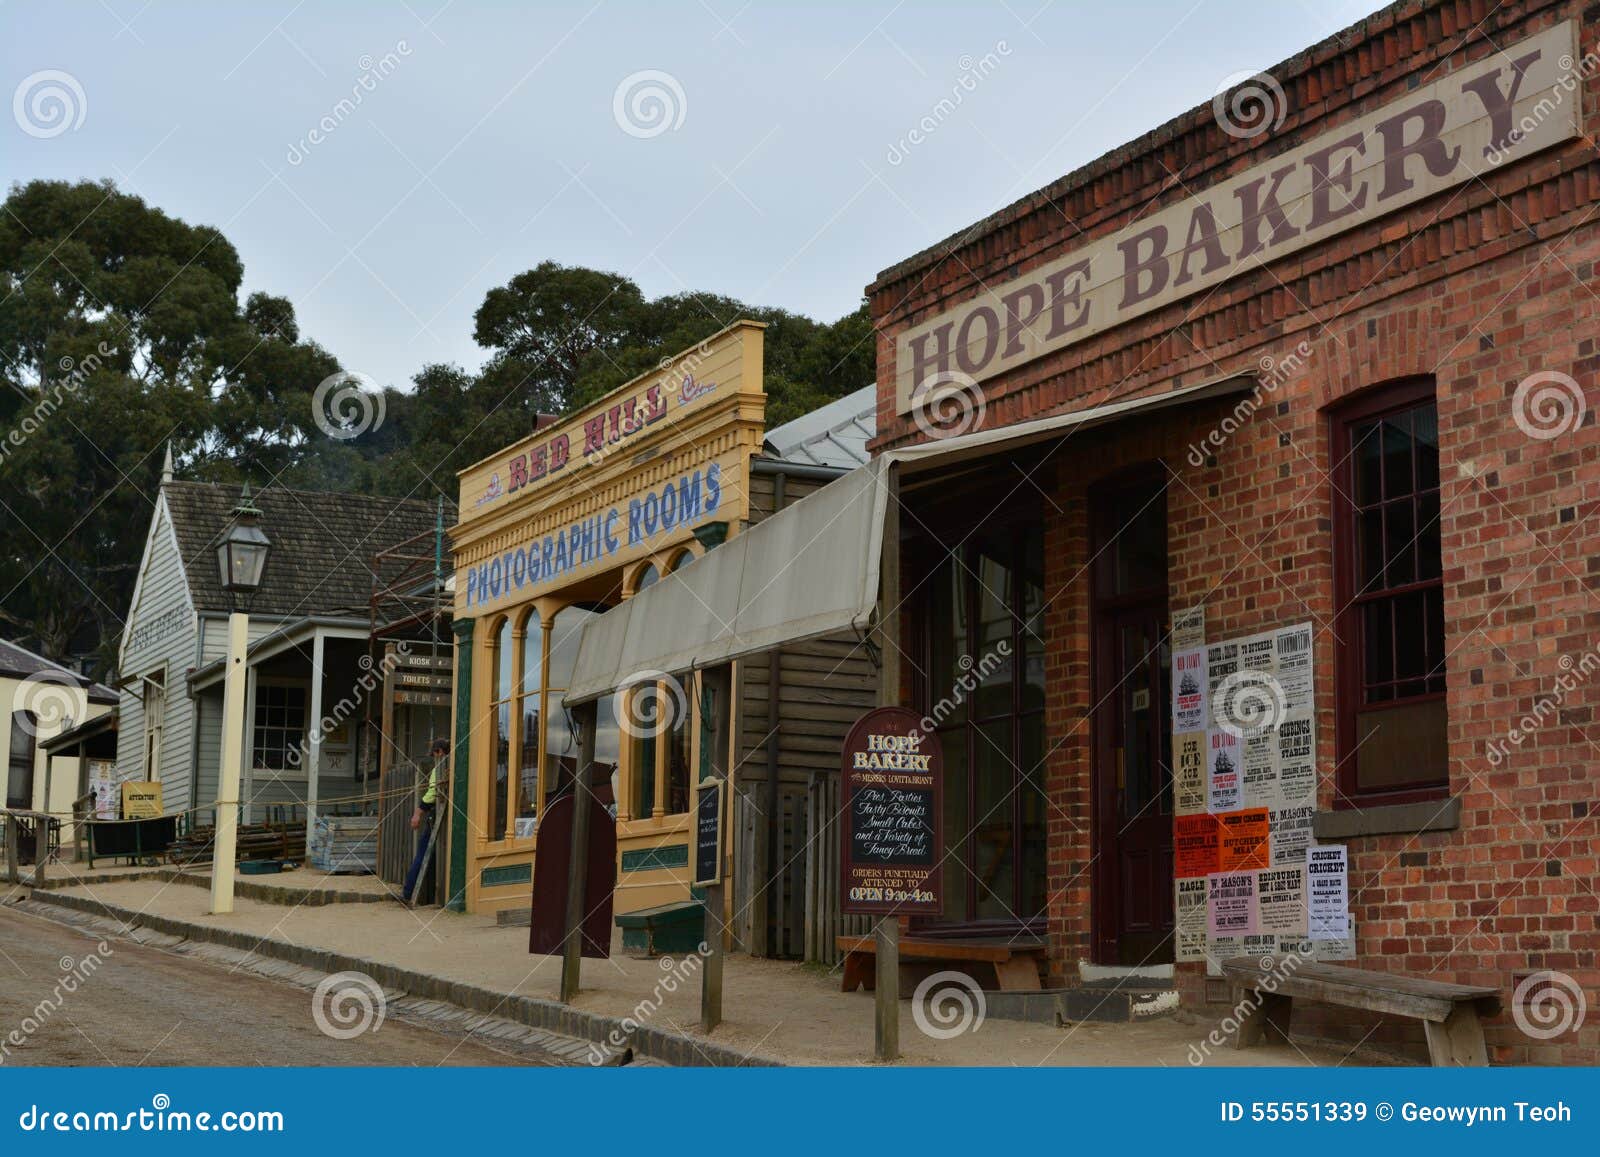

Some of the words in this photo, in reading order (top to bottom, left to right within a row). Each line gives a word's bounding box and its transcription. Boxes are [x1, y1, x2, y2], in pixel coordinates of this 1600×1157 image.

[908, 258, 1092, 399] HOPE
[1117, 49, 1542, 311] BAKERY
[508, 434, 569, 493] RED
[583, 383, 667, 457] HILL
[466, 508, 620, 608] PHOTOGRAPHIC
[628, 463, 723, 553] ROOMS
[409, 657, 431, 666] KIOSK
[402, 675, 431, 685] TOILETS
[1279, 719, 1311, 738] GIBBINGS
[867, 735, 920, 753] HOPE
[1184, 741, 1198, 753] ICE
[1281, 746, 1311, 759] STABLES
[853, 752, 932, 773] BAKERY
[1181, 753, 1201, 768] ICE
[1184, 768, 1198, 779] ICE
[855, 802, 888, 818] Tasty
[1279, 806, 1313, 821] MASON'S
[861, 815, 895, 828] Small
[895, 816, 923, 829] Cakes
[855, 831, 874, 841] and
[863, 842, 895, 859] Fancy
[1312, 851, 1342, 861] CRICKET
[852, 868, 882, 878] ORDERS
[884, 869, 929, 879] PUNCTUALLY
[1309, 862, 1345, 873] CRICKET
[1259, 869, 1301, 882] EDINBURGH
[861, 878, 903, 887] ATTENDED
[906, 879, 919, 887] TO
[1180, 880, 1205, 892] EAGLE
[1221, 876, 1253, 889] MASON'S
[850, 887, 883, 901] OPEN
